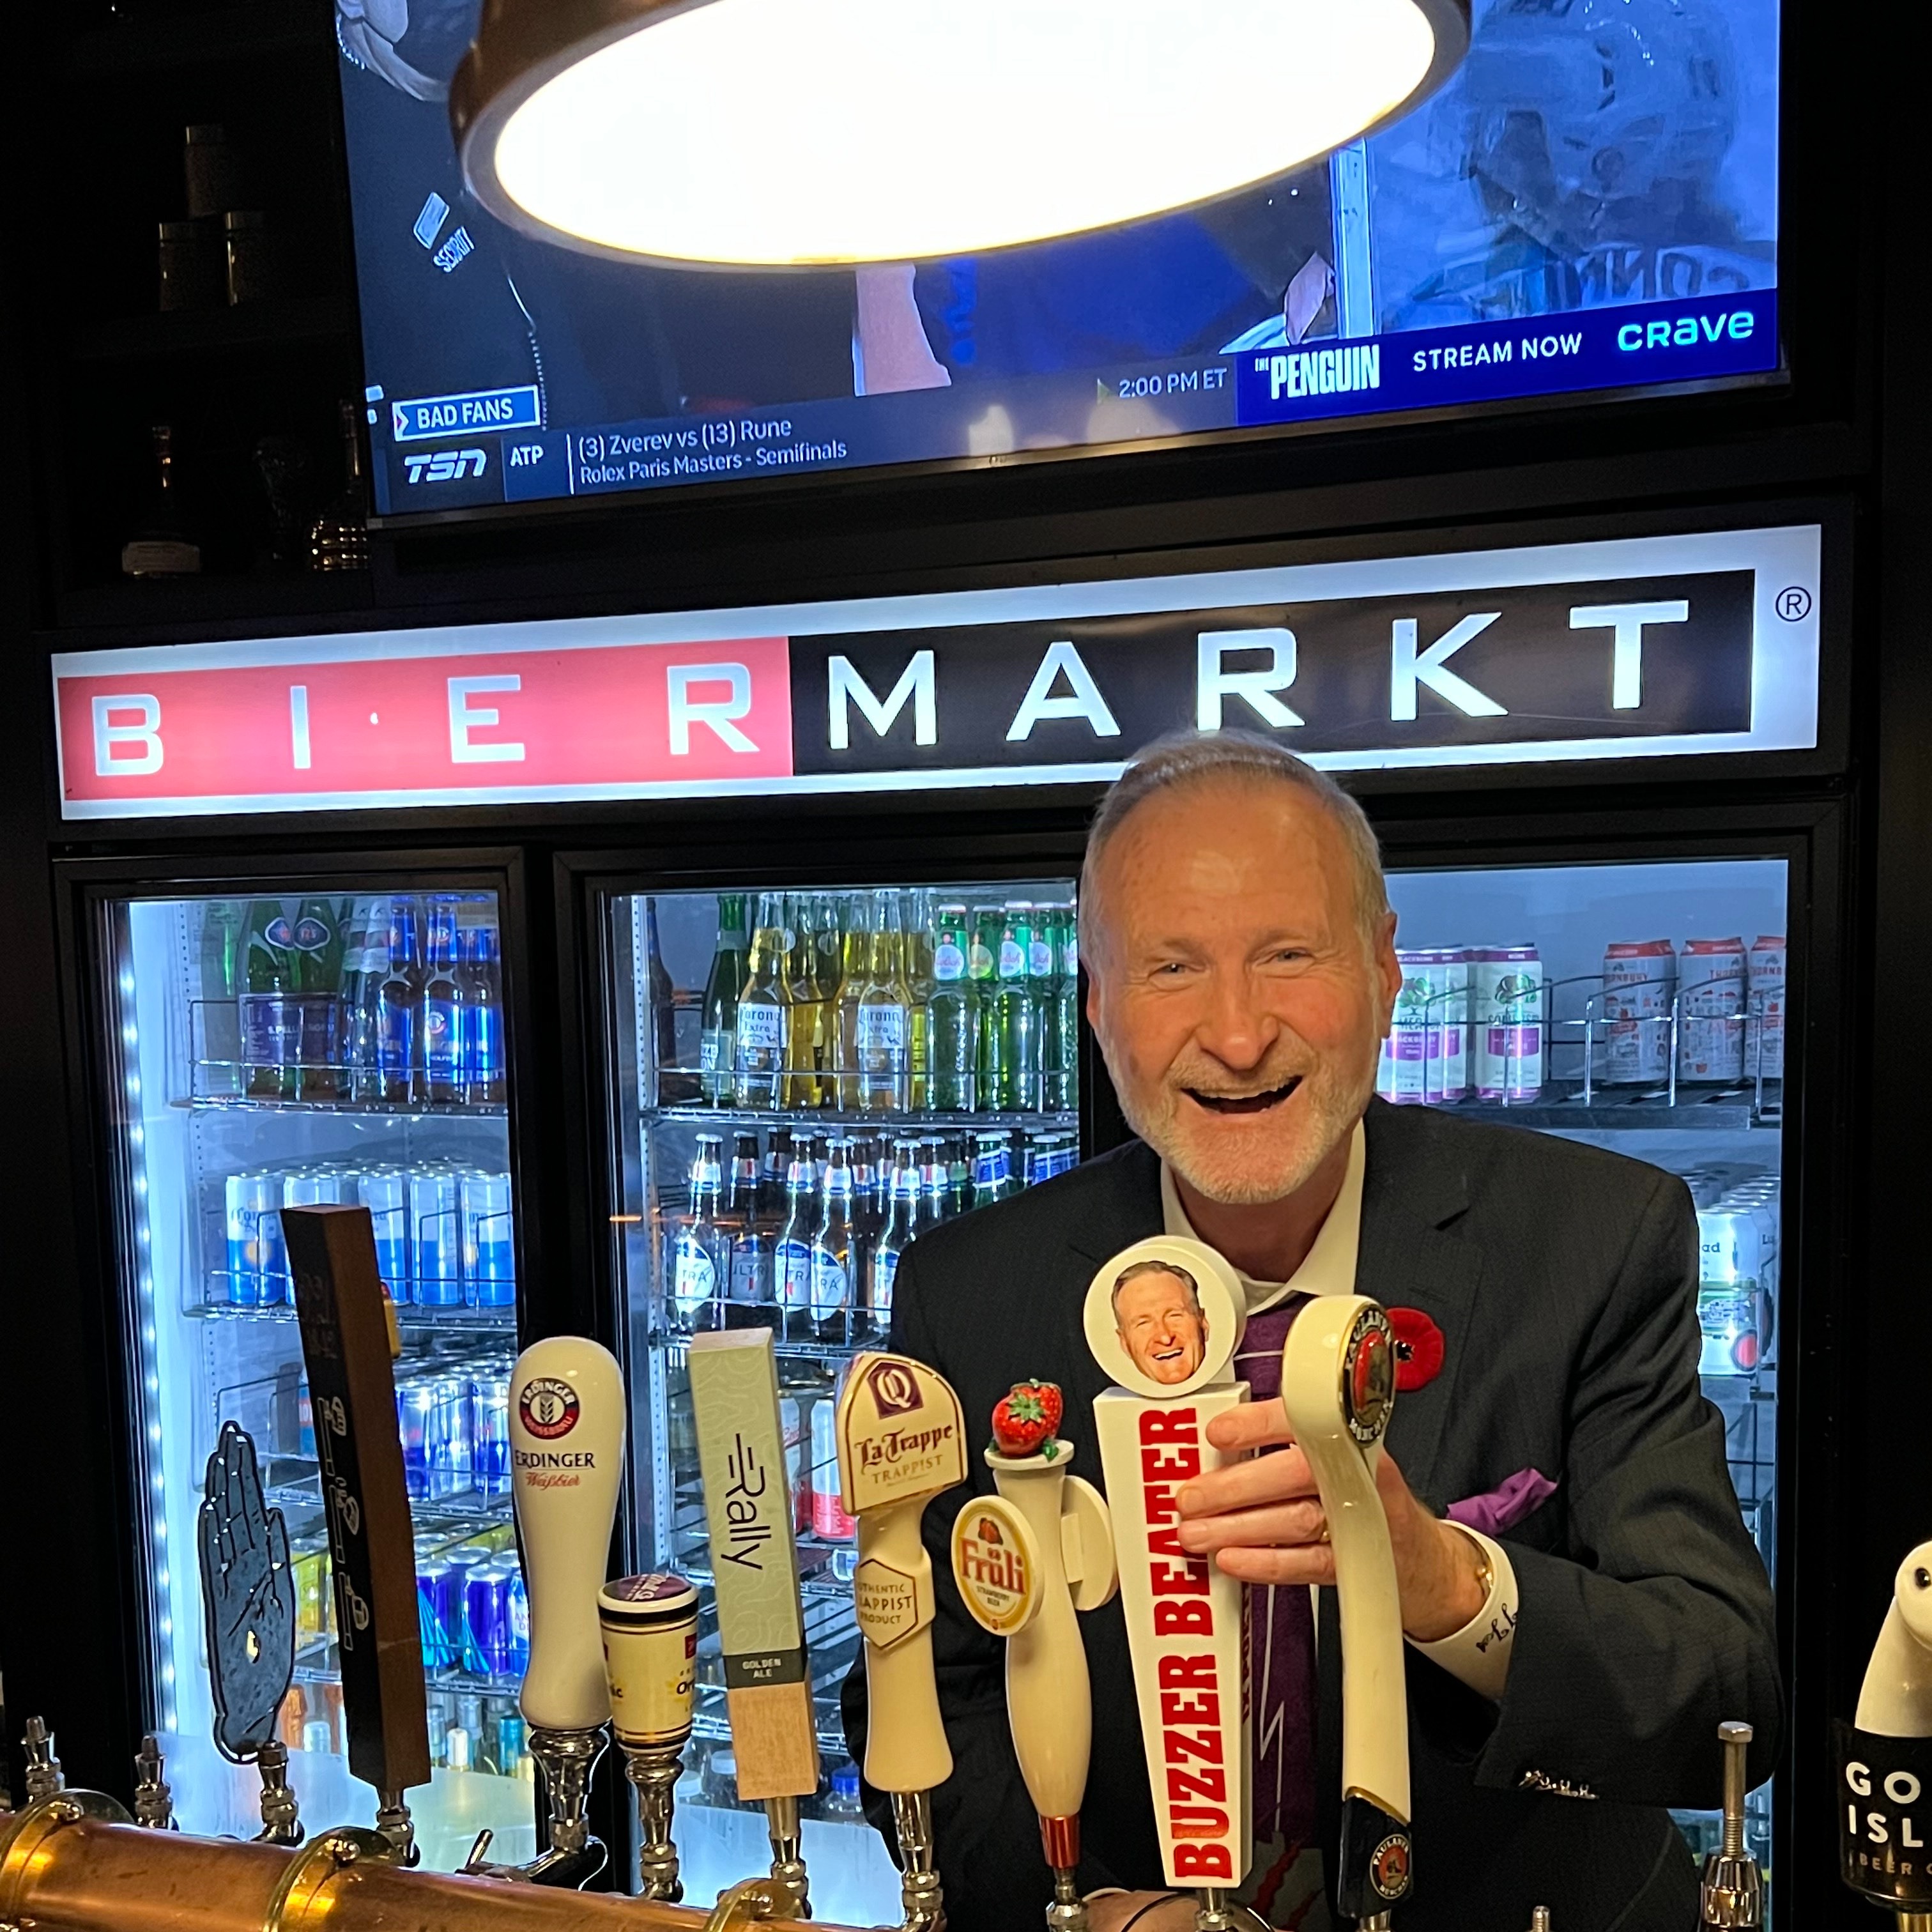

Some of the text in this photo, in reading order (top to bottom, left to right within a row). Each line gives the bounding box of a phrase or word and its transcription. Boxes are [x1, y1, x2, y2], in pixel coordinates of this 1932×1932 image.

[1119, 367, 1228, 399] 2:00 PM ET
[1270, 344, 1381, 400] PENGUIN
[1412, 342, 1513, 372] STREAM
[1521, 333, 1583, 360] NOW
[417, 398, 514, 429] BAD FANS
[510, 445, 544, 467] ATP
[578, 419, 792, 464] (3) Zverev vs (13) Rune
[403, 448, 487, 484] TSN
[580, 465, 625, 485] Rolex
[629, 458, 670, 480] Paris
[673, 453, 742, 475] Masters
[755, 440, 848, 467] Semifinals
[91, 662, 761, 777] BIER
[827, 599, 1690, 749] MARKT
[514, 1450, 596, 1469] ERDINGER
[854, 1425, 953, 1476] La Trappe
[871, 1454, 944, 1484] TRAPPIST
[720, 1433, 772, 1571] Rally
[858, 1583, 905, 1594] THENTIC
[859, 1595, 913, 1611] APPIST
[1138, 1407, 1233, 1880] BUZZER BEATER
[742, 1658, 781, 1670] GOLDEN
[753, 1668, 772, 1679] ALE
[1845, 1761, 1921, 1804] GO
[1848, 1804, 1924, 1848] ISL
[1859, 1852, 1913, 1875] BEER
